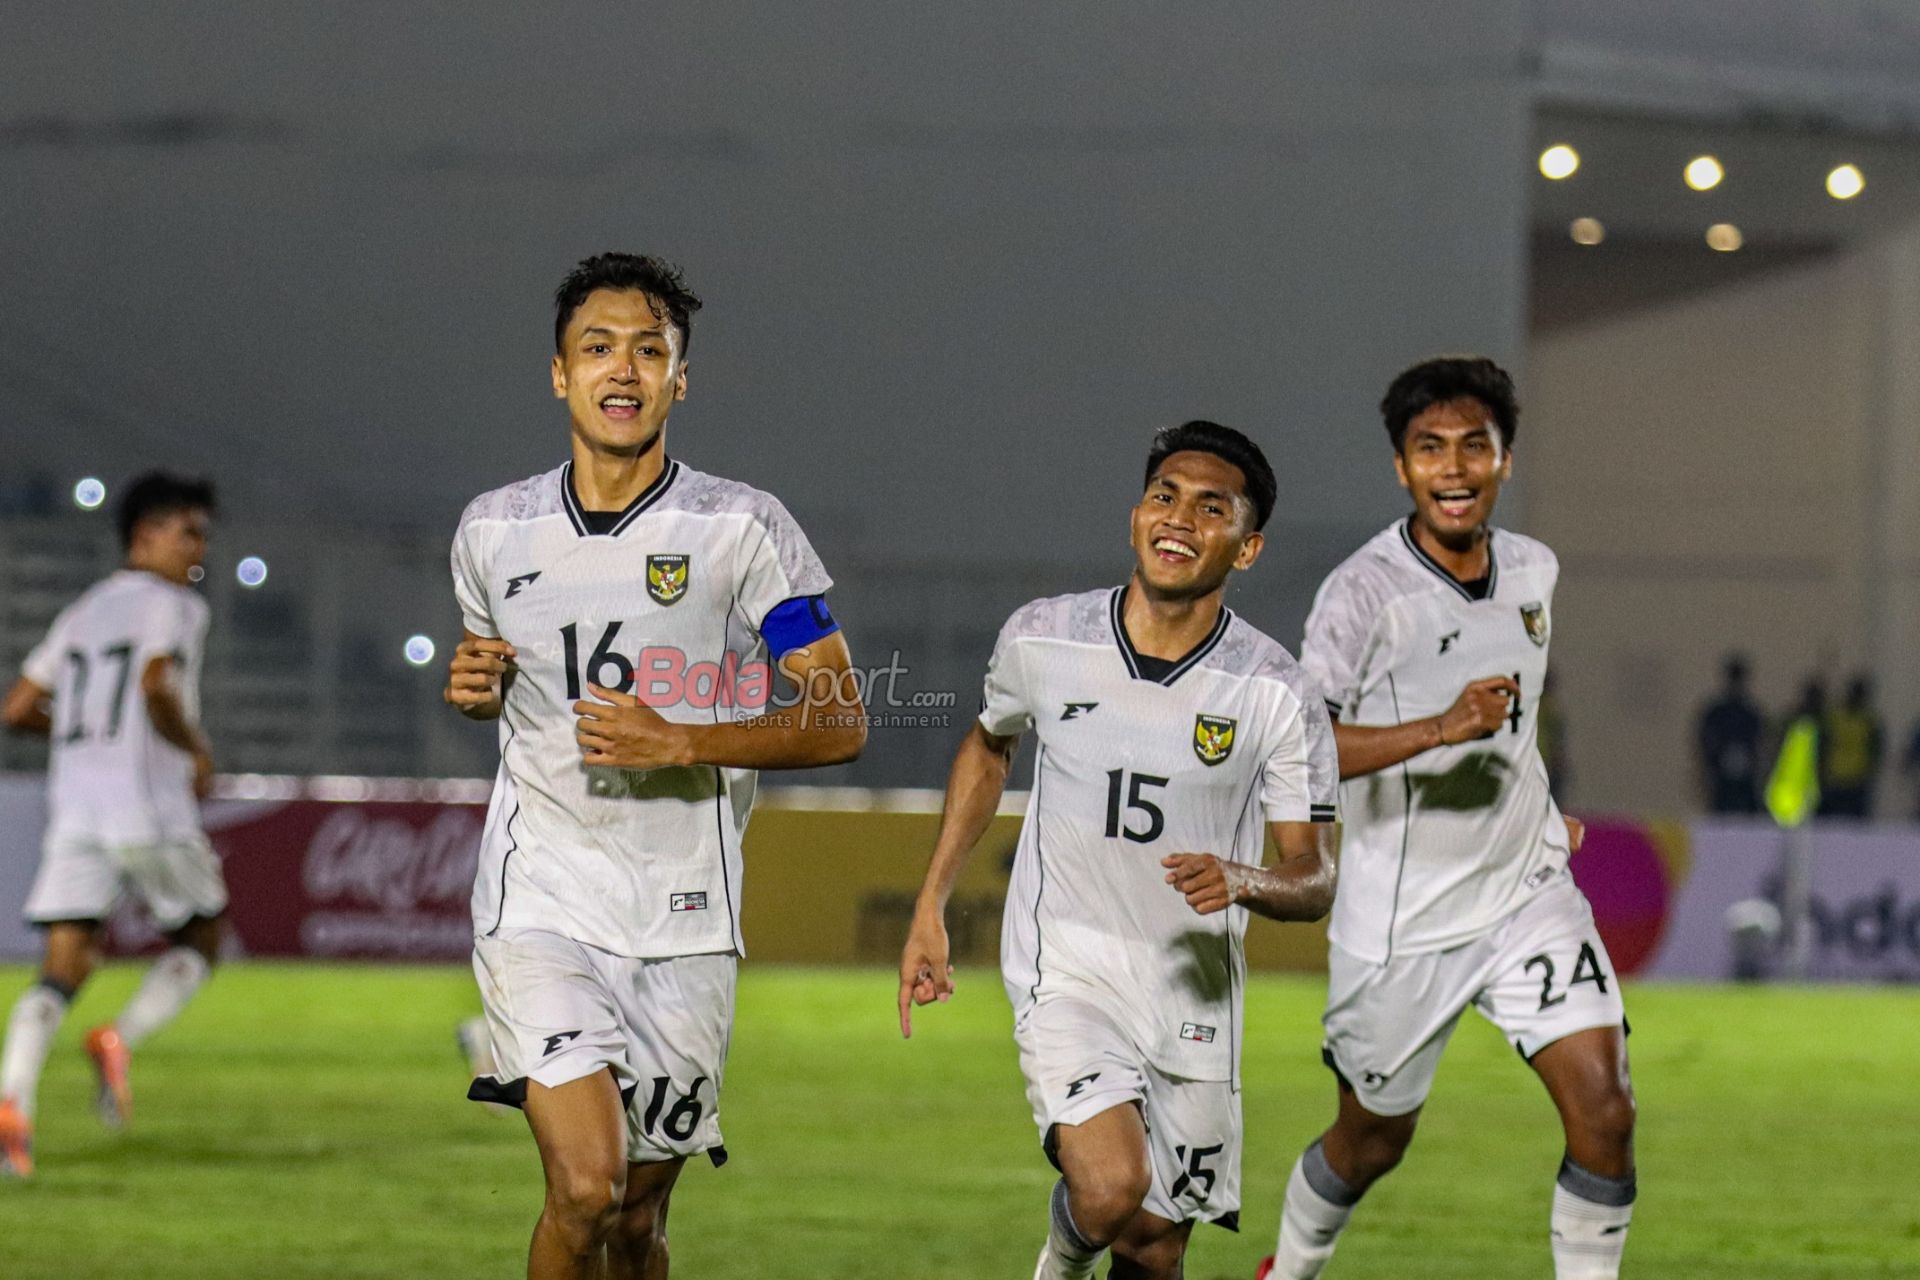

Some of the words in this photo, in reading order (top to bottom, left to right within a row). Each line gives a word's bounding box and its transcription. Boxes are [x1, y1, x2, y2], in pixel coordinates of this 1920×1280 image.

[559, 620, 635, 701] 16
[1104, 767, 1171, 844] 15
[1524, 941, 1609, 1012] 24
[644, 1076, 709, 1142] 16
[1171, 1142, 1225, 1203] 15
